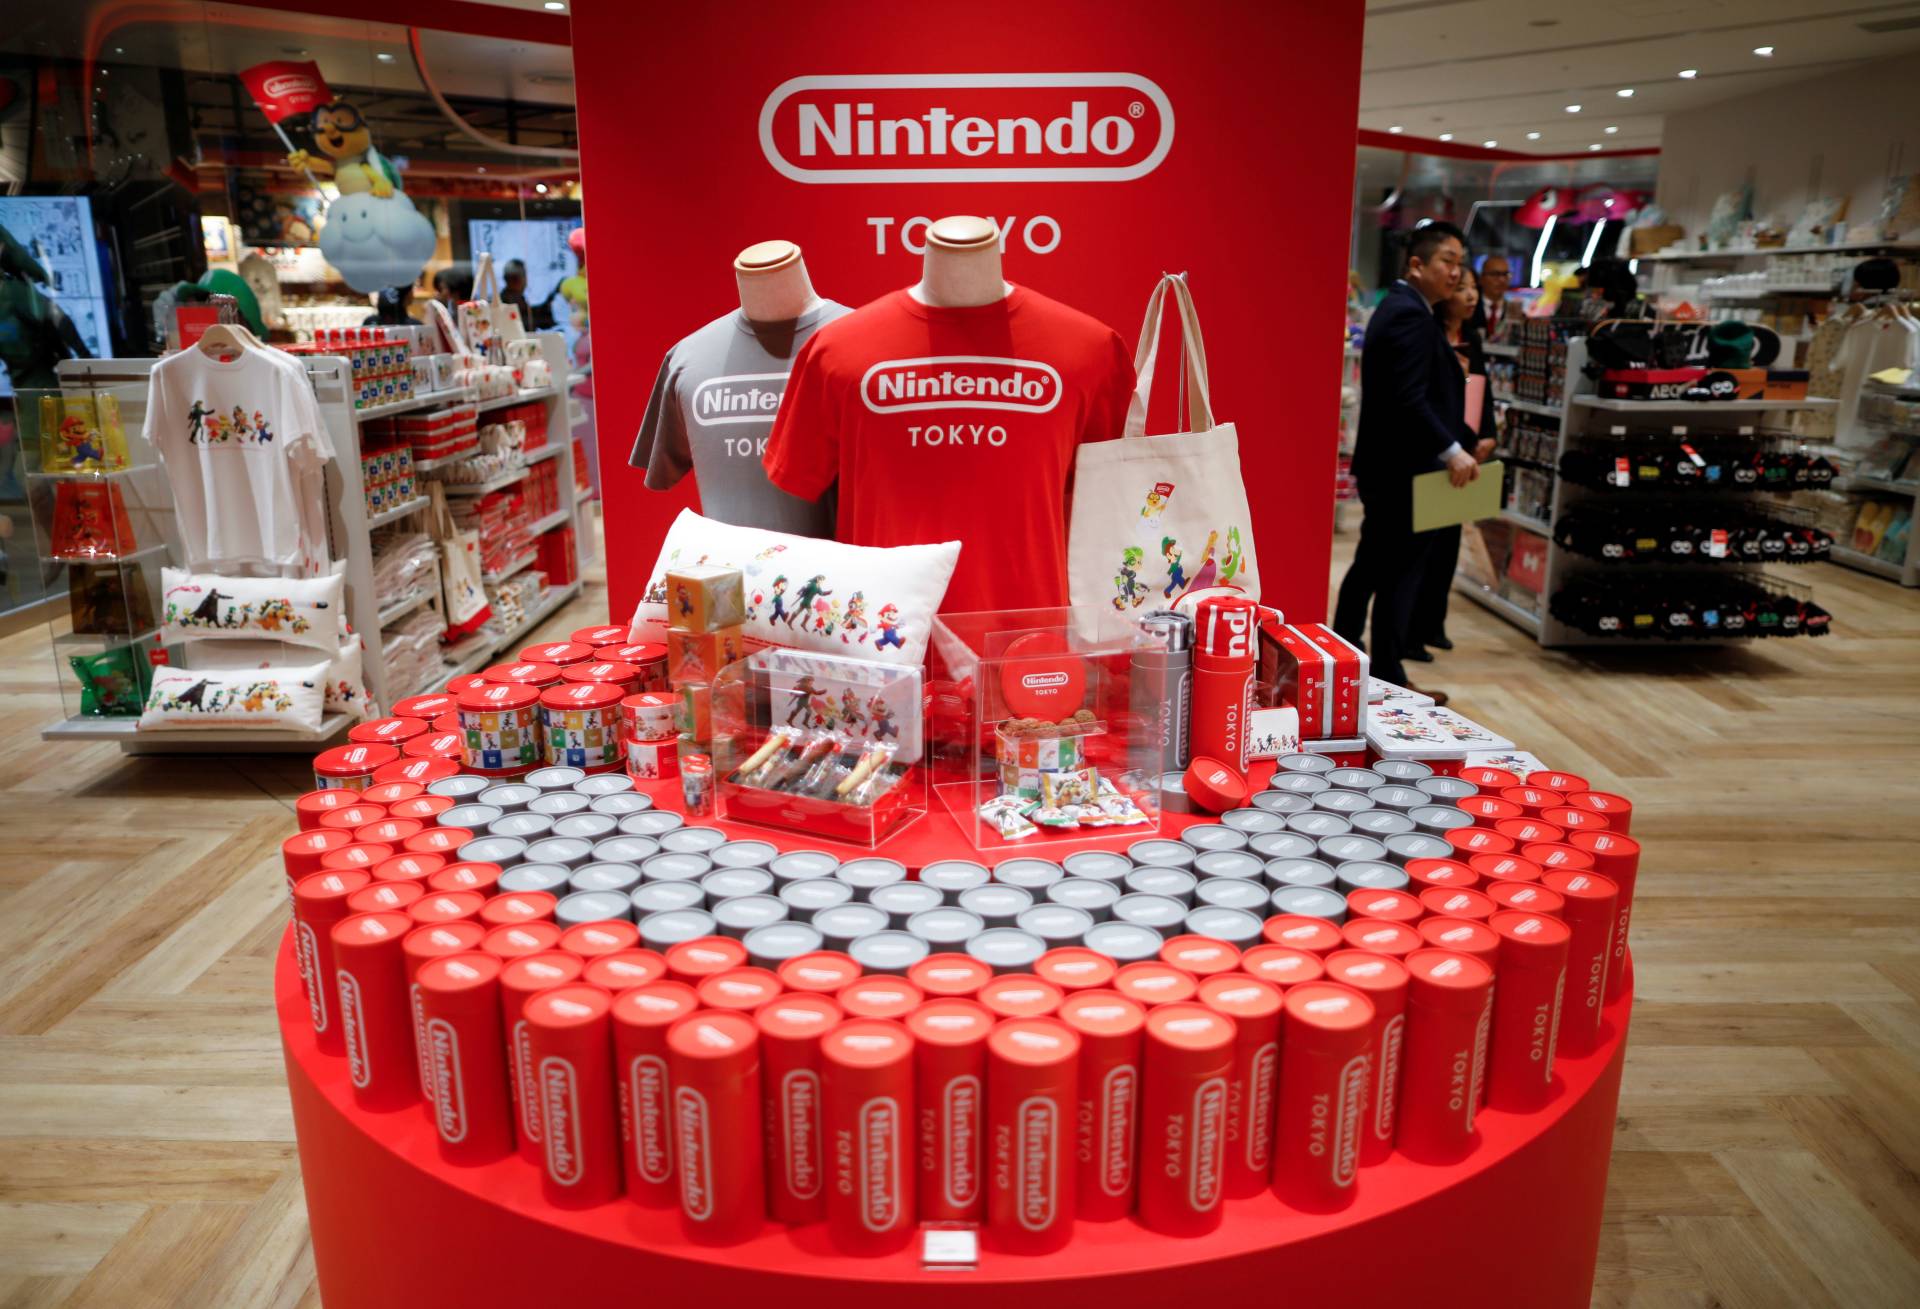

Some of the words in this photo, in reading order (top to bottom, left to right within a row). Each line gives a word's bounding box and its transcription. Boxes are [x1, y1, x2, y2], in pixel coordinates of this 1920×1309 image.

[867, 215, 1061, 254] TOYO
[703, 388, 784, 414] Ninte
[908, 425, 1007, 447] TOKYO
[1225, 704, 1237, 751] TOKYO
[1616, 906, 1629, 957] TOKYO
[1587, 953, 1603, 1007] TOKYO
[340, 979, 363, 1076] Nintendo
[1530, 1003, 1549, 1061] TOKYO
[432, 1030, 456, 1132] Nintendo
[1448, 1050, 1468, 1110] TOKYO
[547, 1068, 573, 1173] Nintendo
[640, 1067, 664, 1171] Nintendo
[791, 1081, 814, 1188] Nintendo
[953, 1087, 973, 1196] Nintendo
[1079, 1101, 1094, 1162] TOKYO
[1165, 1114, 1184, 1177] TOKYO
[1199, 1089, 1221, 1200] Nintendo
[1309, 1094, 1329, 1156] TOKYO
[682, 1098, 704, 1207] Nintendo
[836, 1130, 853, 1195] TOKYO
[870, 1109, 892, 1219] Nintendo
[1027, 1109, 1049, 1218] Nintendo
